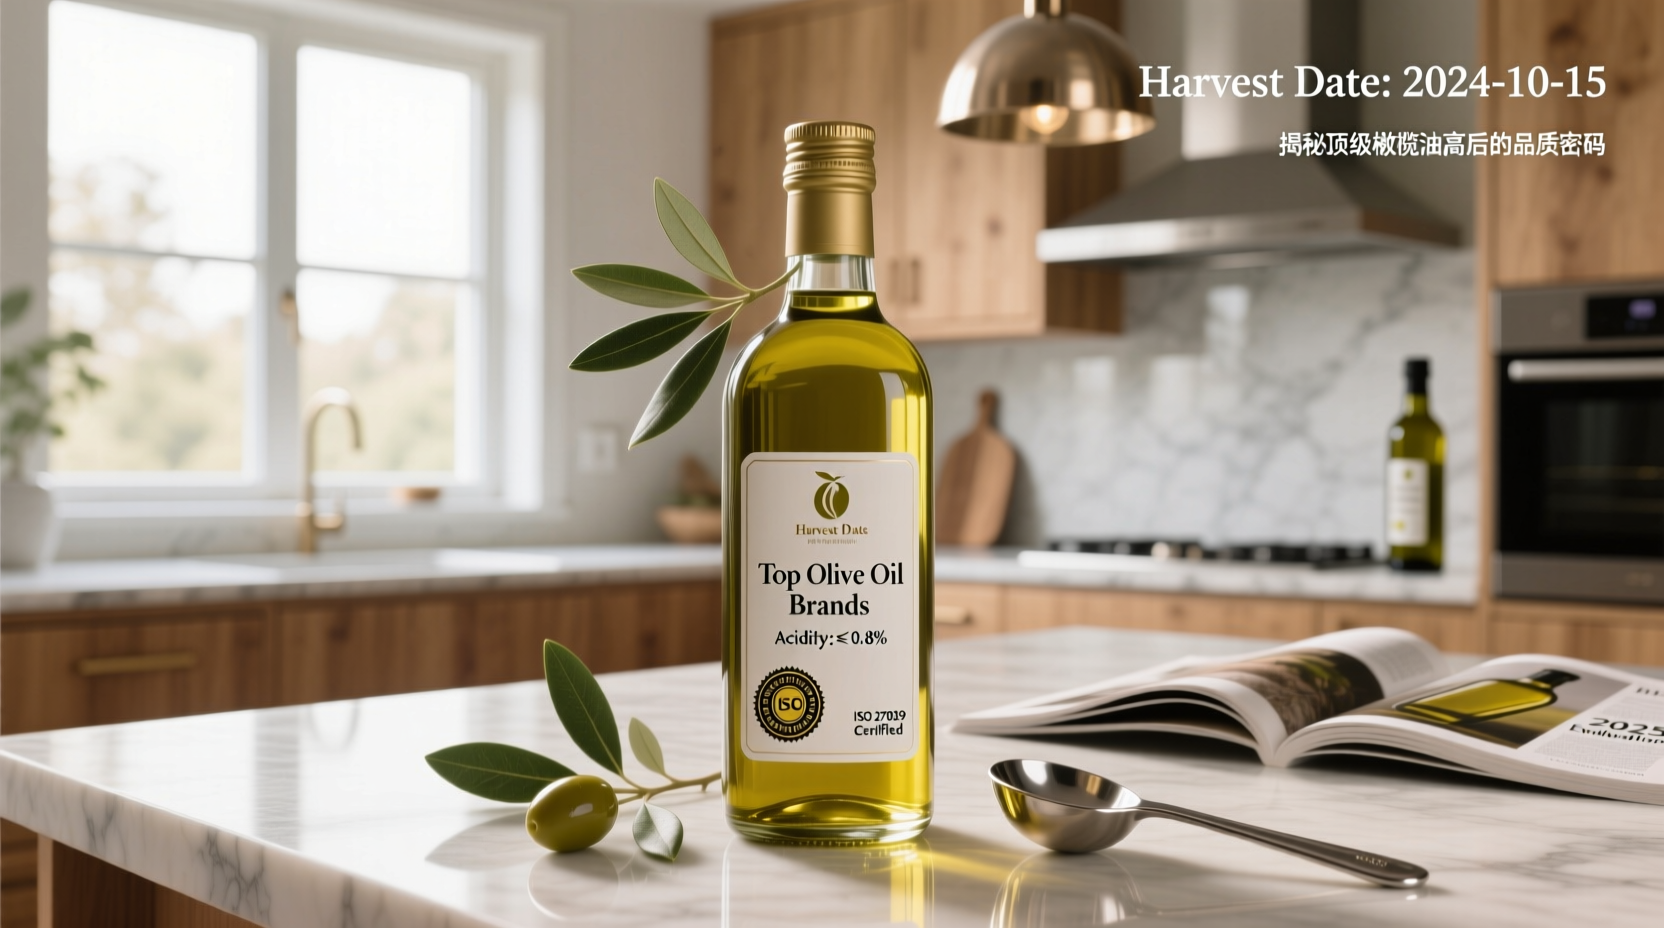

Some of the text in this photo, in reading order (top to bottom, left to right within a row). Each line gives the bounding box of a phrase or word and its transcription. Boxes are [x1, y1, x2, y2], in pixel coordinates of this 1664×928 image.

[758, 562, 904, 591] Top Olive Oil
[789, 593, 870, 615] Brands
[778, 697, 803, 711] ISO
[854, 711, 872, 722] ISO
[1588, 717, 1664, 737] 2025
